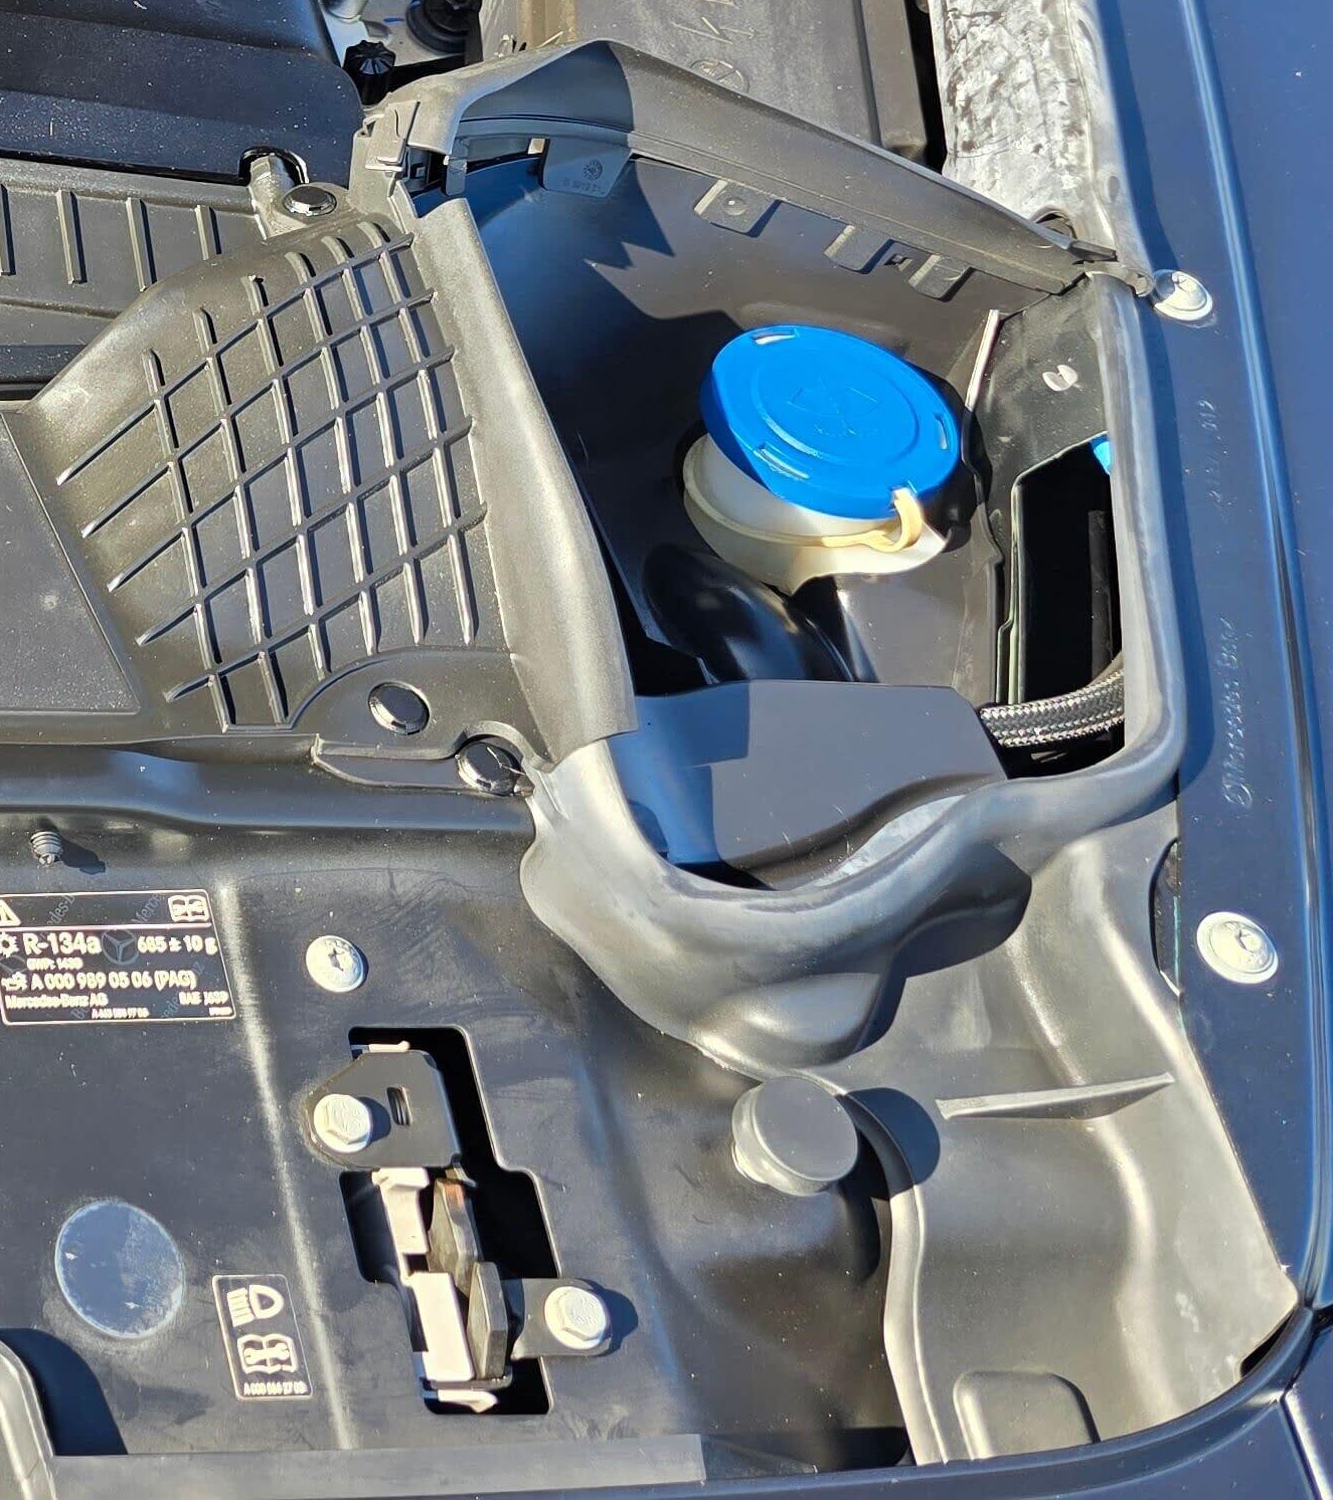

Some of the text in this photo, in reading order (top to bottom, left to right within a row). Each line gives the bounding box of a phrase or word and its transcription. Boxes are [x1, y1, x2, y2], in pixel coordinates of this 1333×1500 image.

[22, 931, 102, 956] R-134a
[137, 936, 168, 953] 685
[183, 935, 204, 952] 10
[205, 938, 218, 956] g
[31, 969, 197, 992] A 000 989 05 06 (PAG)
[4, 993, 90, 1009] Mercedes-Benz
[90, 992, 109, 1007] AG
